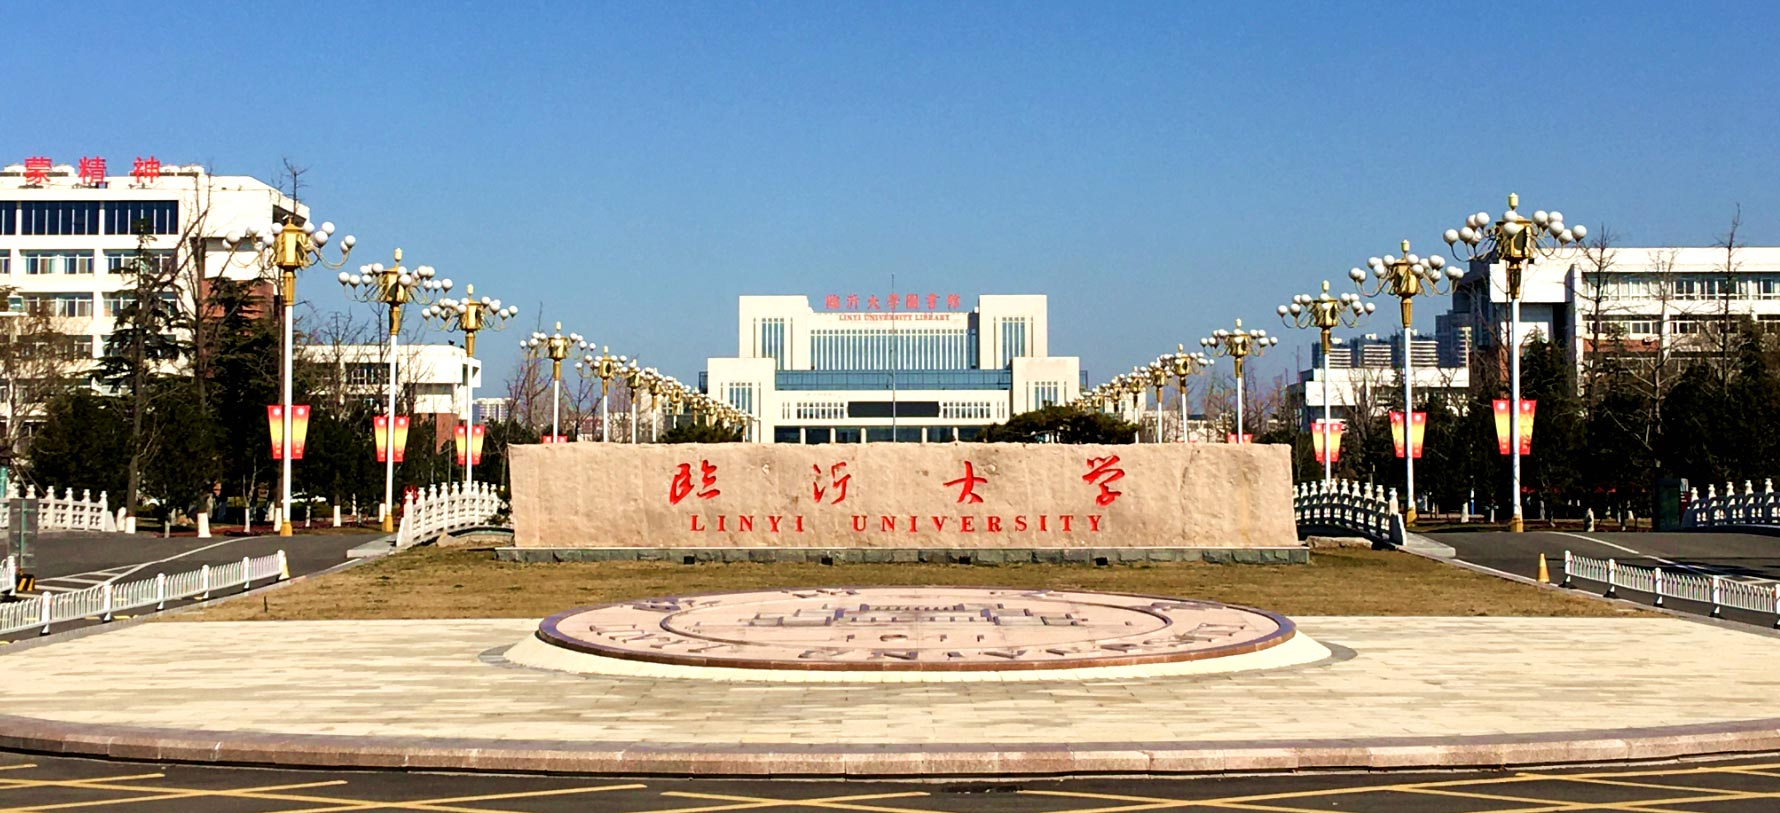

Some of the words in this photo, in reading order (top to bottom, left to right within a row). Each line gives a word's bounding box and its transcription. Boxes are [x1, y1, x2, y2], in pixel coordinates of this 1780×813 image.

[24, 155, 161, 185] 蒙精神
[690, 514, 805, 532] LINYI
[852, 514, 1105, 532] UNIVERSITY
